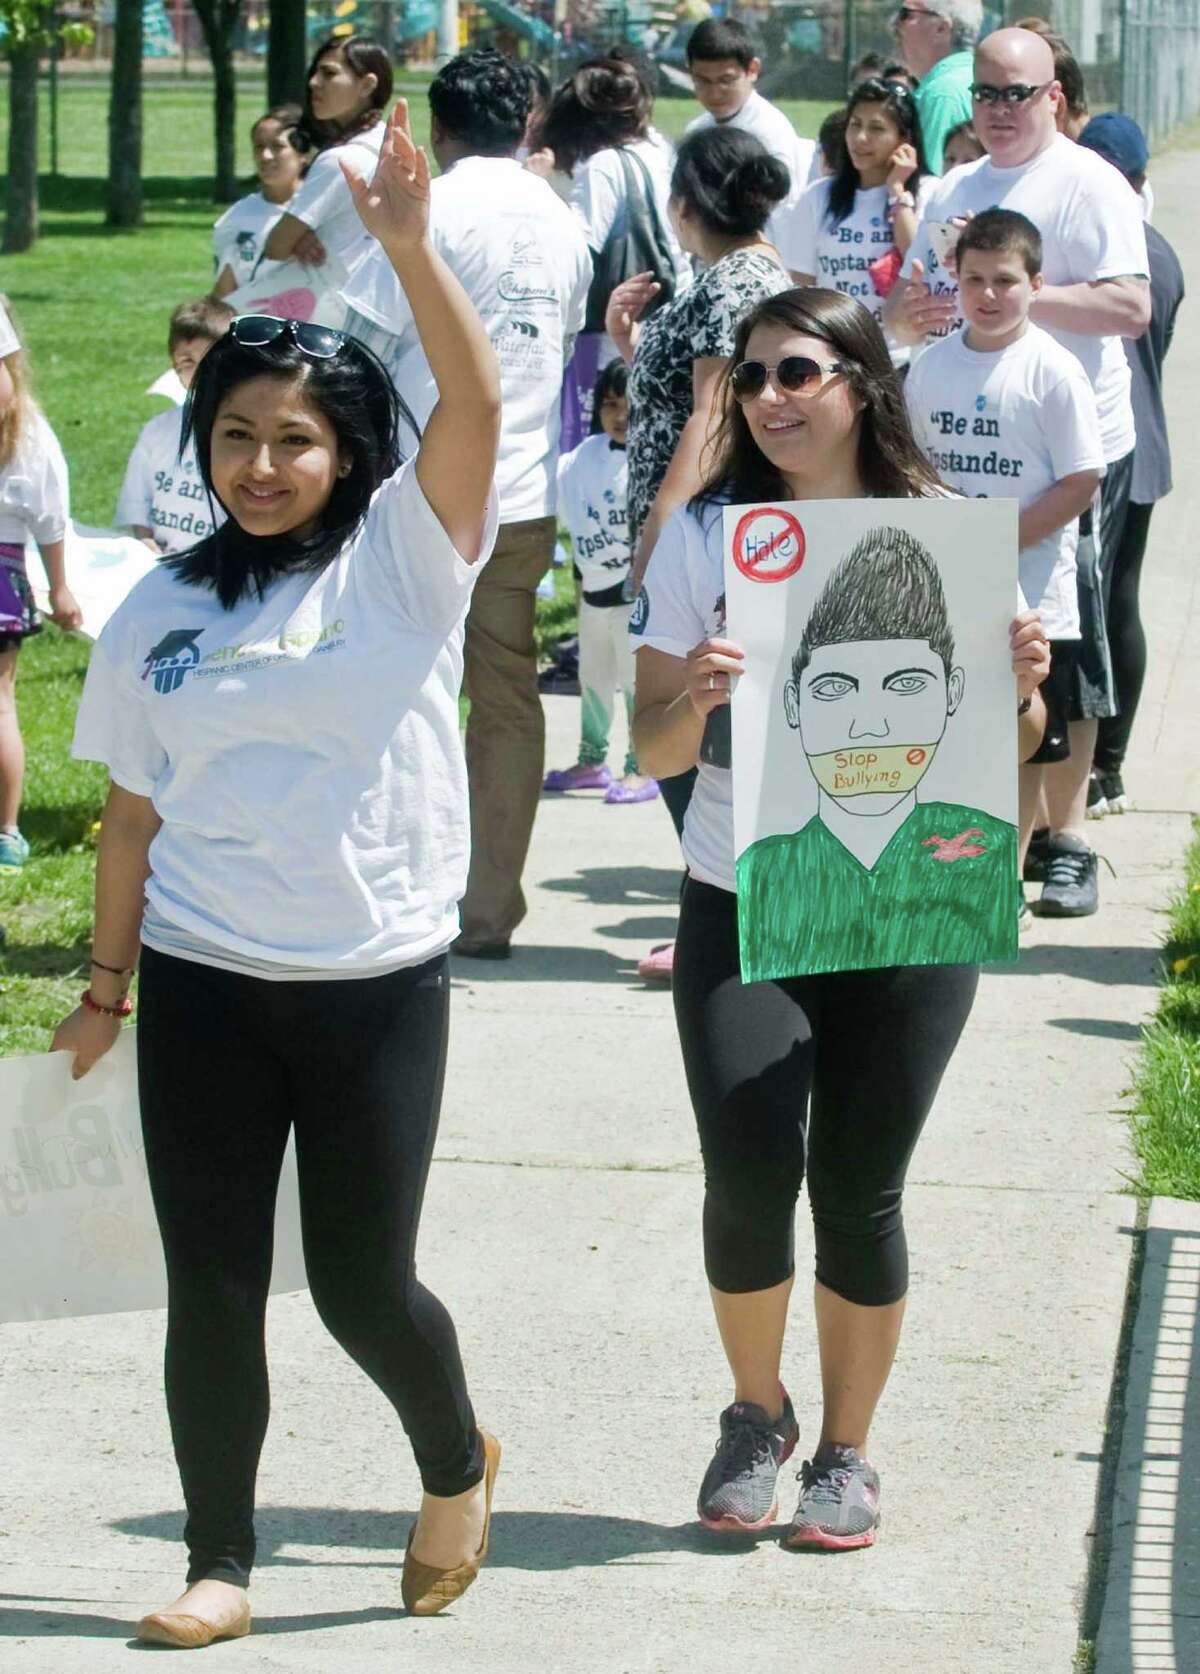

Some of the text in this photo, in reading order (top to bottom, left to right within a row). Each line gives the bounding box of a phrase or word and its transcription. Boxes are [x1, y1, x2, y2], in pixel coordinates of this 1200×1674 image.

[870, 230, 894, 243] an
[972, 417, 1000, 438] an
[745, 530, 793, 565] Hate
[833, 770, 901, 789] Bullying
